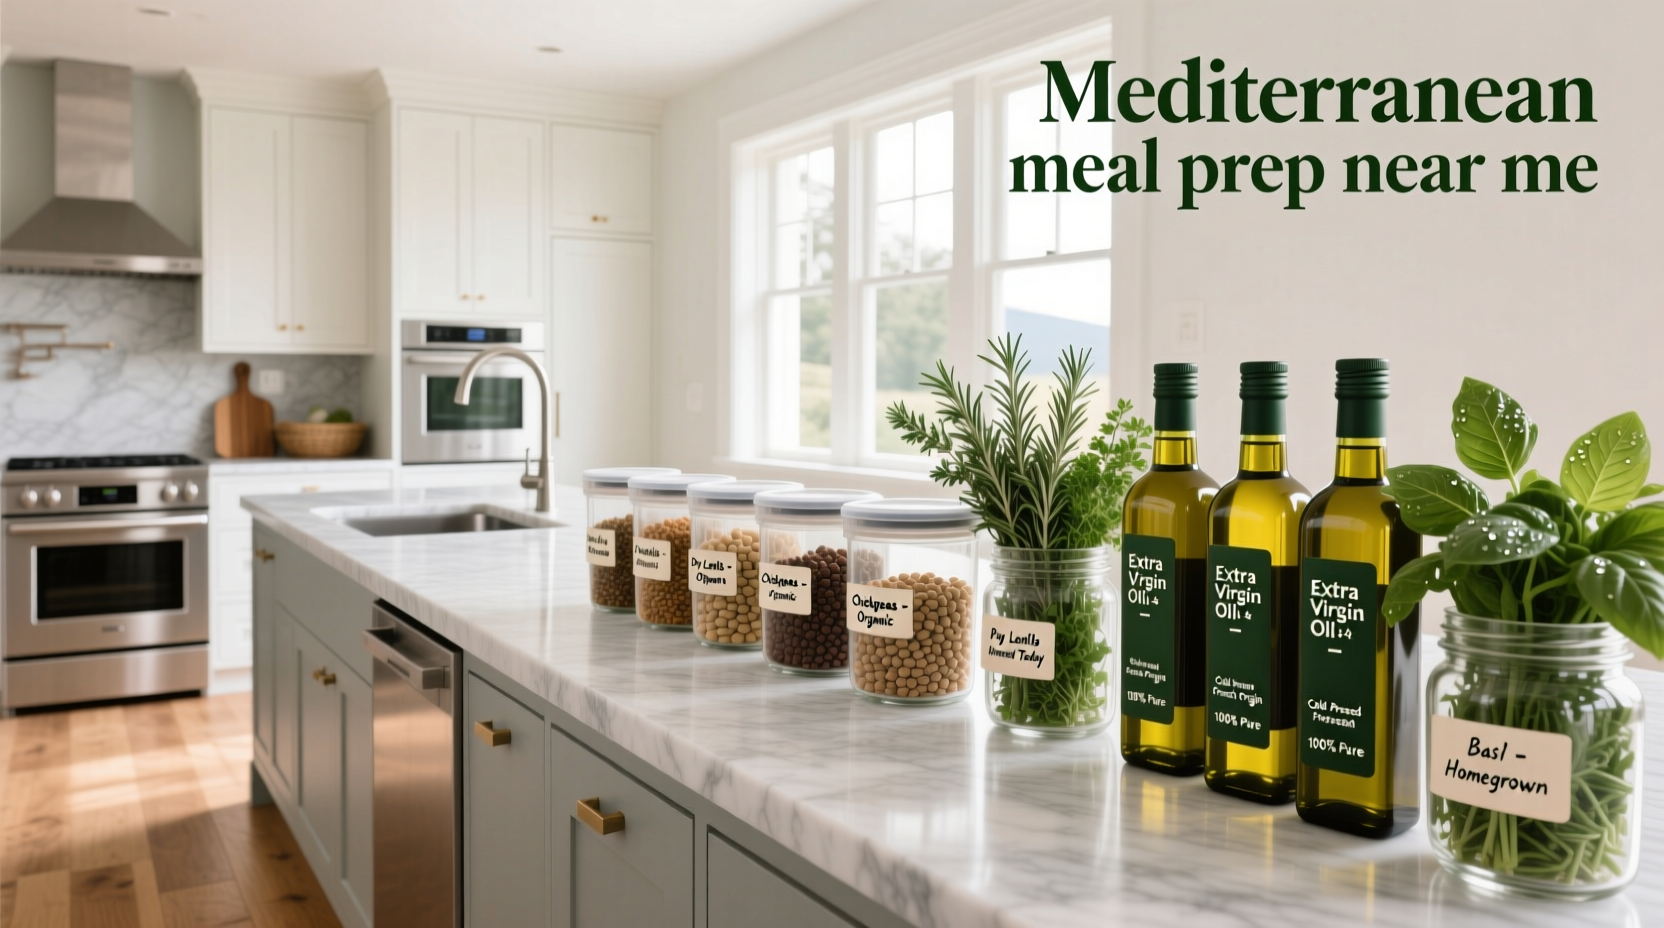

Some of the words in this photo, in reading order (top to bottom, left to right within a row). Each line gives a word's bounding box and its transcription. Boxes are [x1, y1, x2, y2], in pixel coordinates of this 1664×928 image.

[1128, 553, 1163, 571] Extra
[1215, 565, 1256, 584] Extra
[1214, 582, 1261, 606] Virgin
[1311, 579, 1359, 600] Extra
[1309, 598, 1365, 623] Virgin
[1214, 711, 1238, 727] 100%
[1307, 736, 1337, 753] 100%
[1444, 758, 1548, 796] Homegrown
